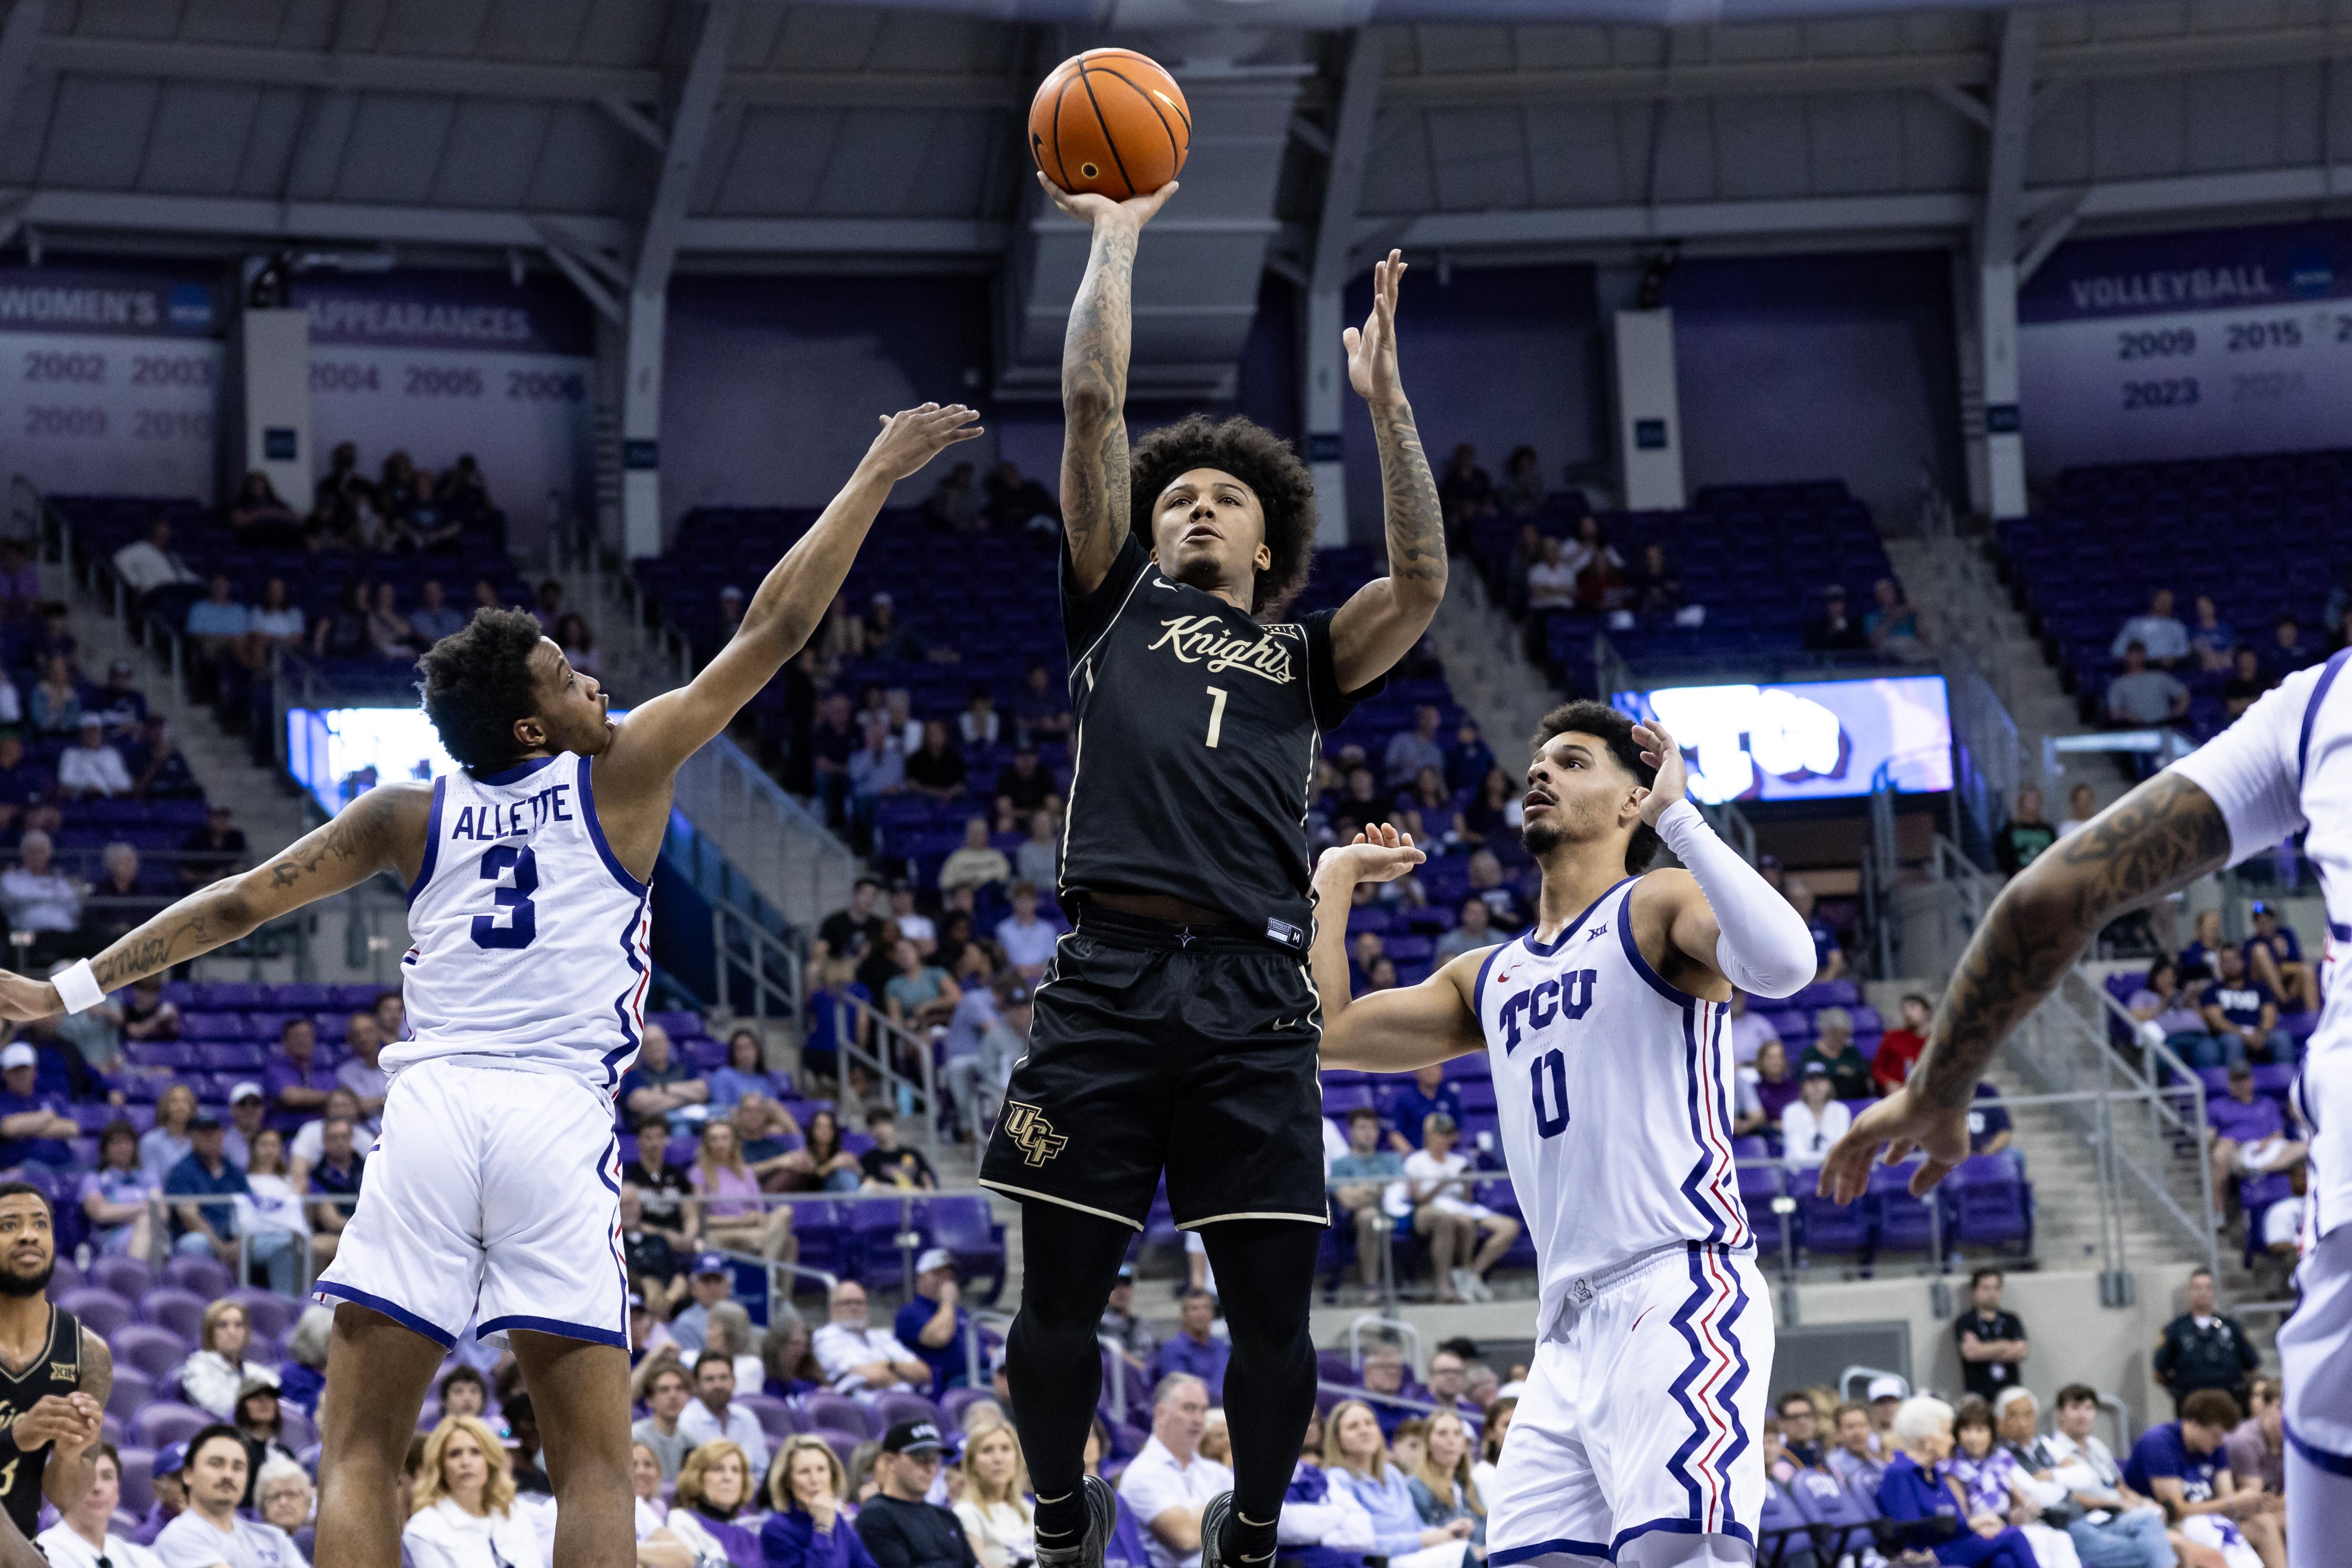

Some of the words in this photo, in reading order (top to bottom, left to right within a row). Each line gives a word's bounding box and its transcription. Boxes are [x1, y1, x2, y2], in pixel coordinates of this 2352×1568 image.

[0, 286, 157, 325] WOMEN'S
[2070, 266, 2272, 309] VOLLEYBALL
[307, 300, 530, 339] APPEARANCES
[2118, 327, 2196, 360] 2009
[2227, 318, 2302, 351] 2015
[24, 352, 106, 383] 2002
[404, 366, 483, 397] 2005
[1148, 615, 1296, 685] Knights
[1205, 686, 1227, 748] 1
[451, 784, 573, 841] ALLETTE
[470, 844, 539, 949] 3
[1292, 932, 1300, 943] M
[1499, 969, 1597, 1058] TCU
[1530, 1048, 1570, 1139] 0
[1004, 1100, 1068, 1168] UCF
